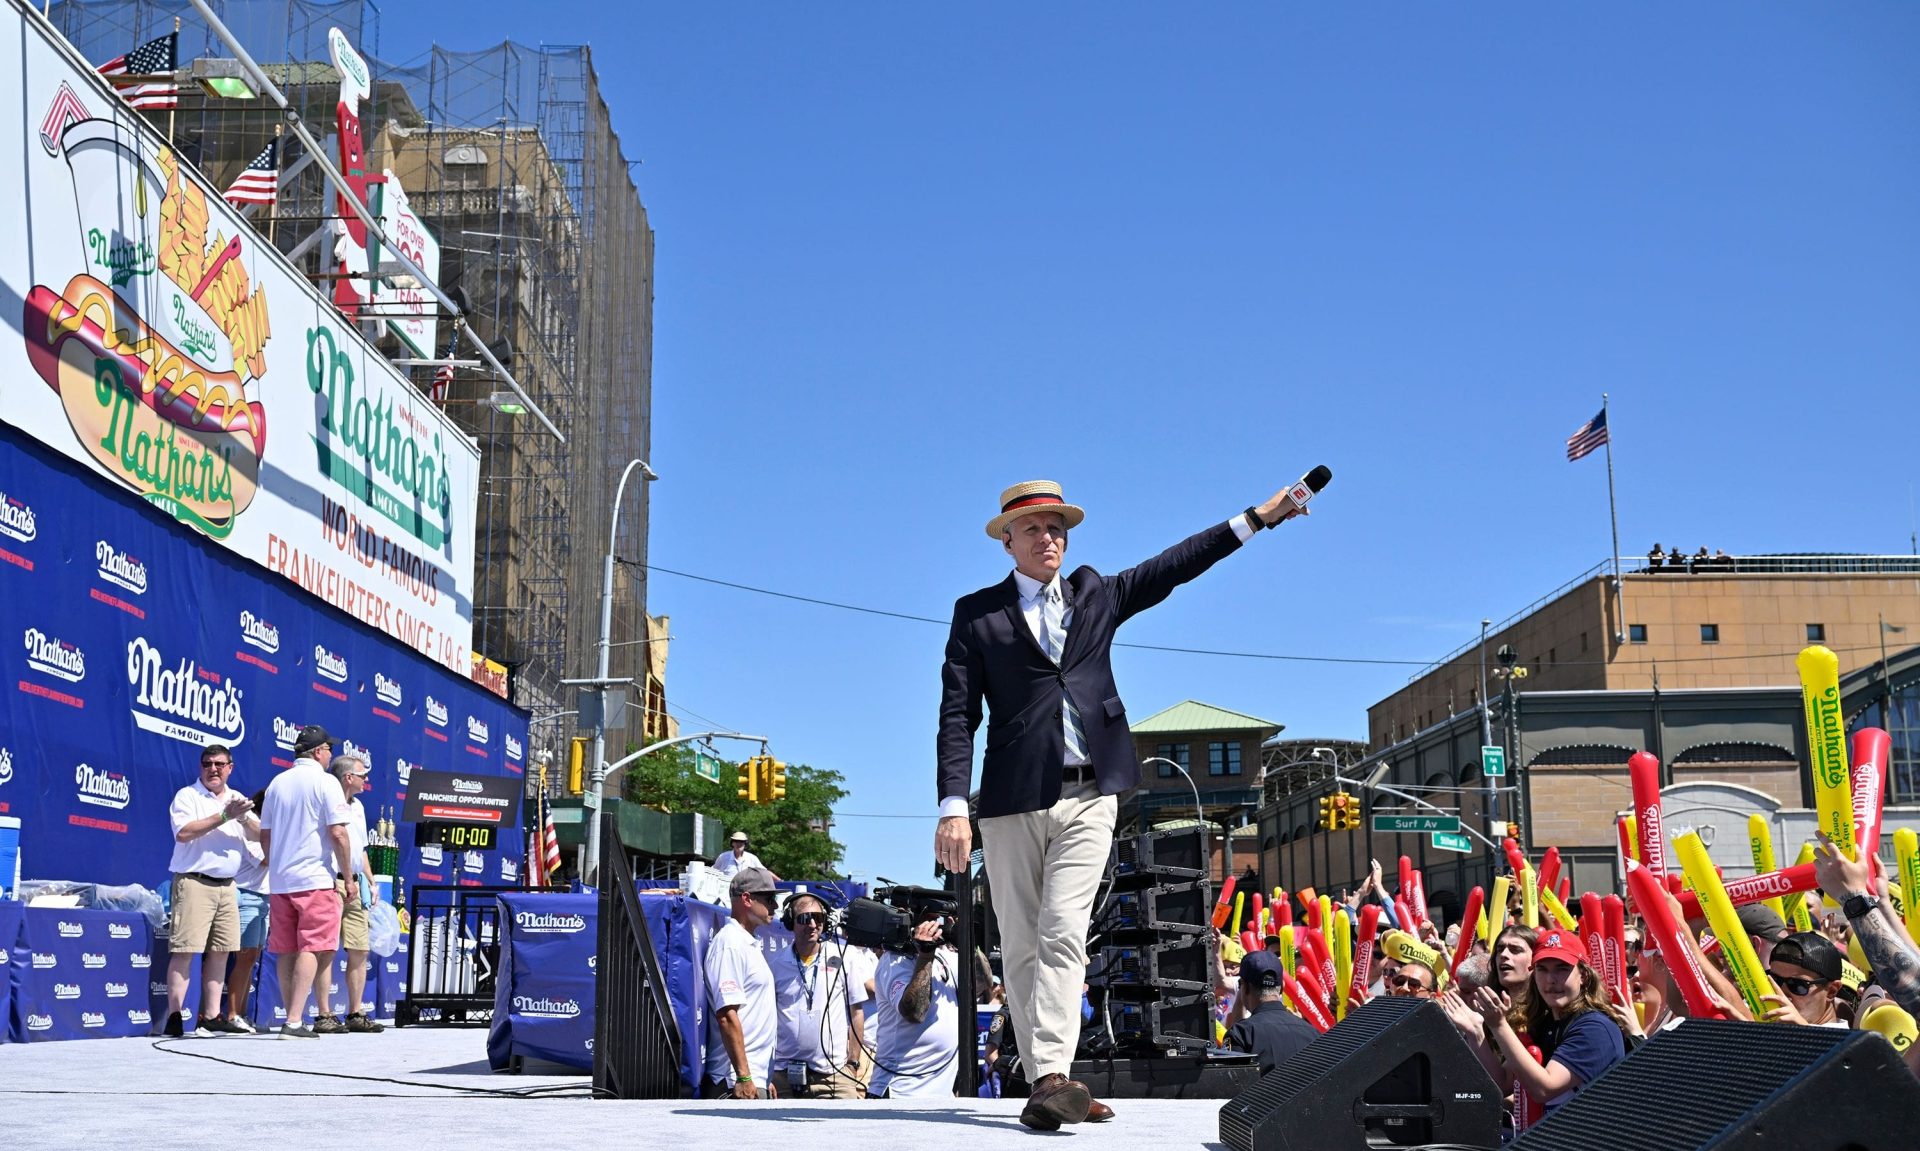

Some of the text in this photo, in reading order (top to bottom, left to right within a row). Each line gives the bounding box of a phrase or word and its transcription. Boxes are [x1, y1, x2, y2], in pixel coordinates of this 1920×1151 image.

[397, 219, 408, 239] FOR
[95, 358, 235, 503] Nathan's
[306, 326, 451, 518] Nathan's
[96, 540, 147, 587] Nathan's
[322, 494, 438, 607] WORLD FAMOUS
[267, 533, 391, 635] FRANKFURTERS
[396, 608, 433, 658] SINCE
[240, 610, 279, 648] Nathan's
[25, 628, 85, 674] Nathan's
[315, 645, 347, 680] Nathan's
[128, 637, 244, 733] Nathan's
[165, 725, 205, 743] FAMOUS
[1820, 686, 1847, 787] Nathan's
[76, 763, 129, 801] Nathan's
[418, 793, 509, 806] FRANCHISE OPPORTUNITIES
[1852, 761, 1875, 831] Nathan's
[1395, 820, 1437, 828] Surf Av
[1831, 811, 1840, 837] Coney
[1646, 803, 1664, 886] Nathan's
[1751, 837, 1762, 874] Nath
[1726, 874, 1792, 897] Natha
[516, 912, 586, 928] Nathan's
[1352, 940, 1372, 989] Nathan's
[513, 996, 580, 1013] Nathan's
